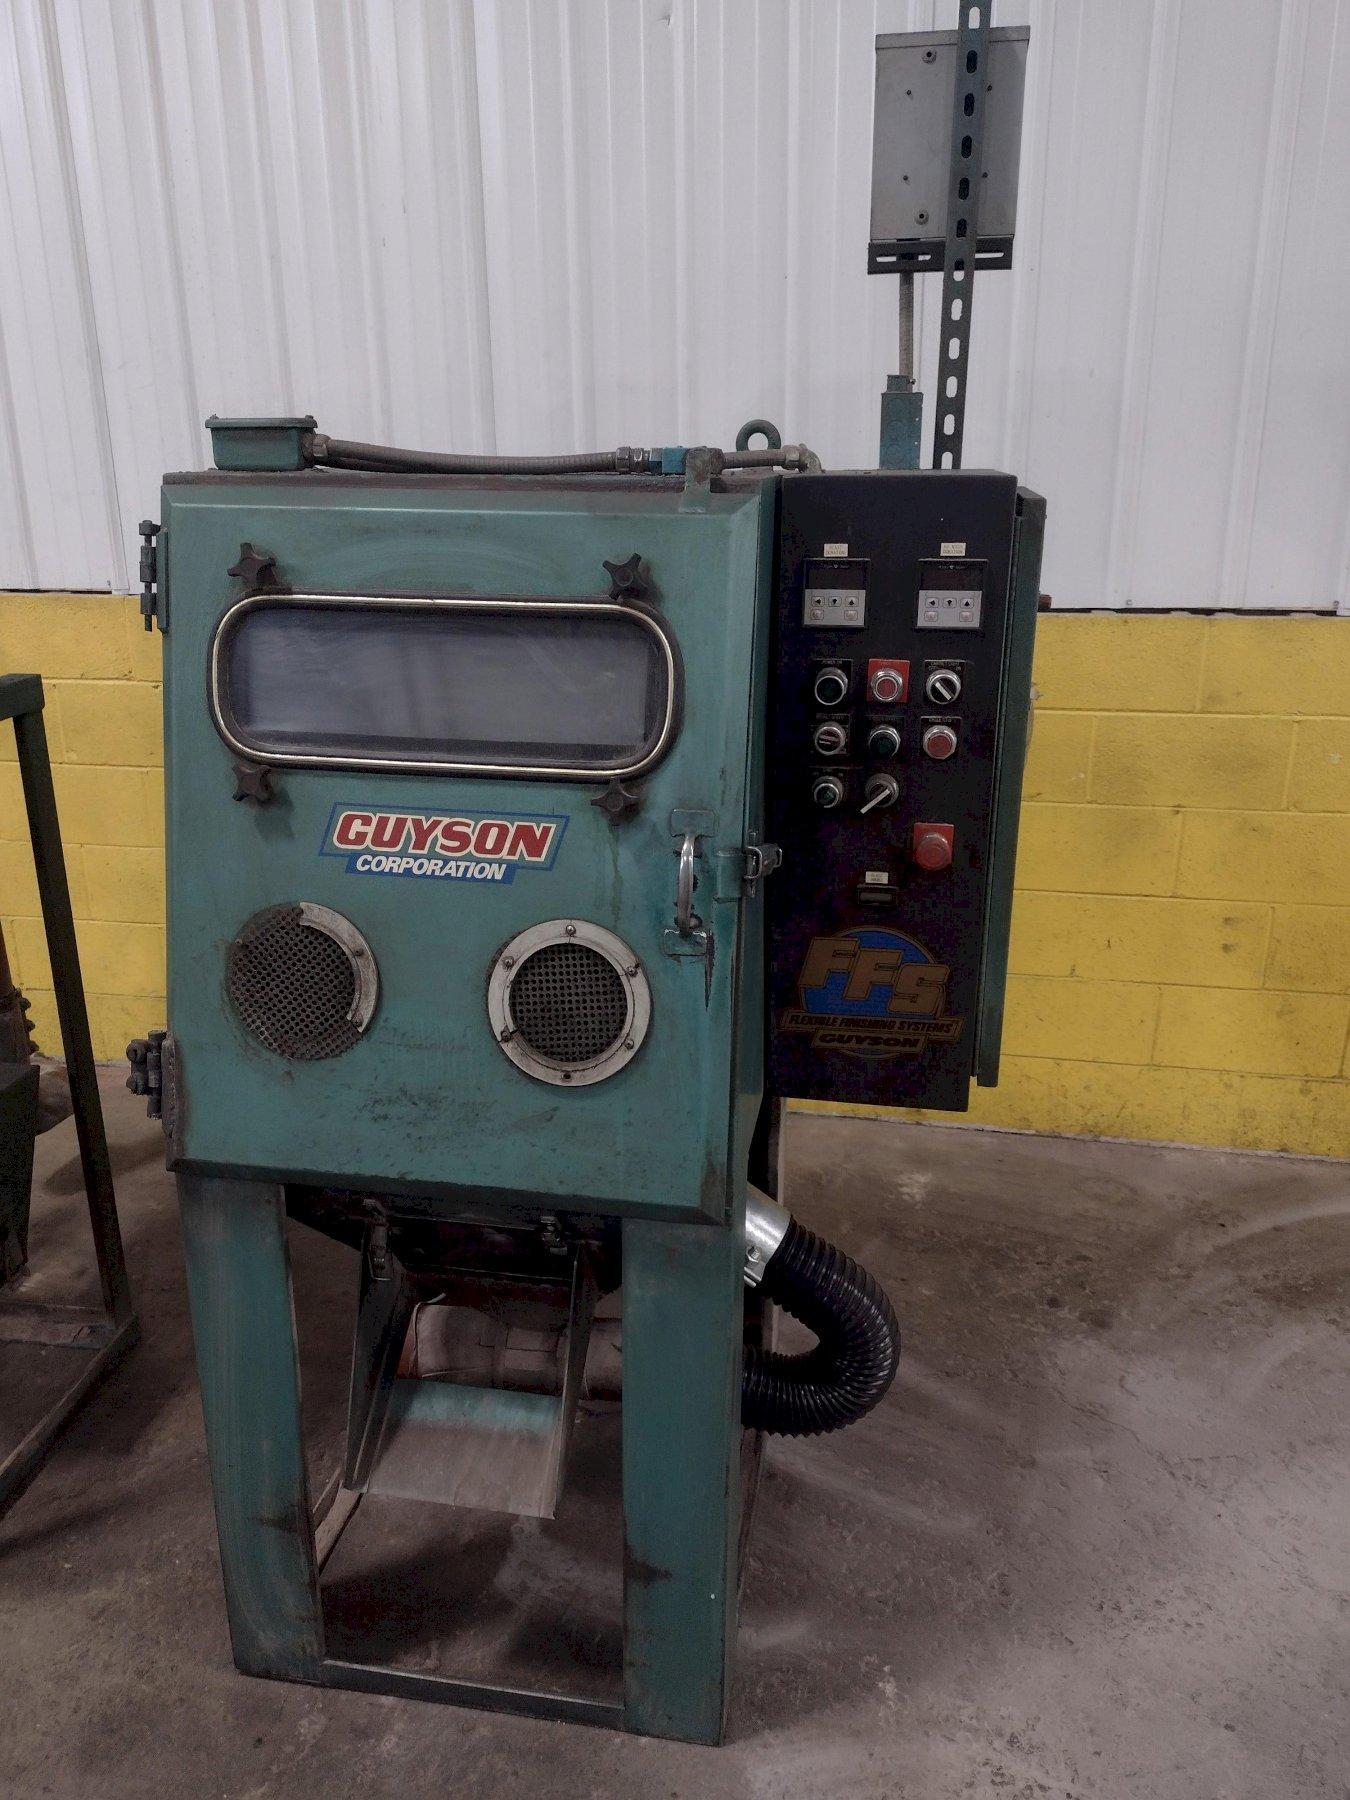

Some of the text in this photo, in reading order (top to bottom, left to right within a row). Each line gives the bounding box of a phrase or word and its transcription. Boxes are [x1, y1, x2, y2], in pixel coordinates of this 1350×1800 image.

[334, 811, 555, 861] GUYSON
[356, 854, 508, 880] CORPORATION
[800, 937, 950, 1017] FFS
[790, 1015, 838, 1027] FLEXIBLE
[898, 1020, 954, 1034] SYSTEMS
[818, 1034, 921, 1048] GUYSON
